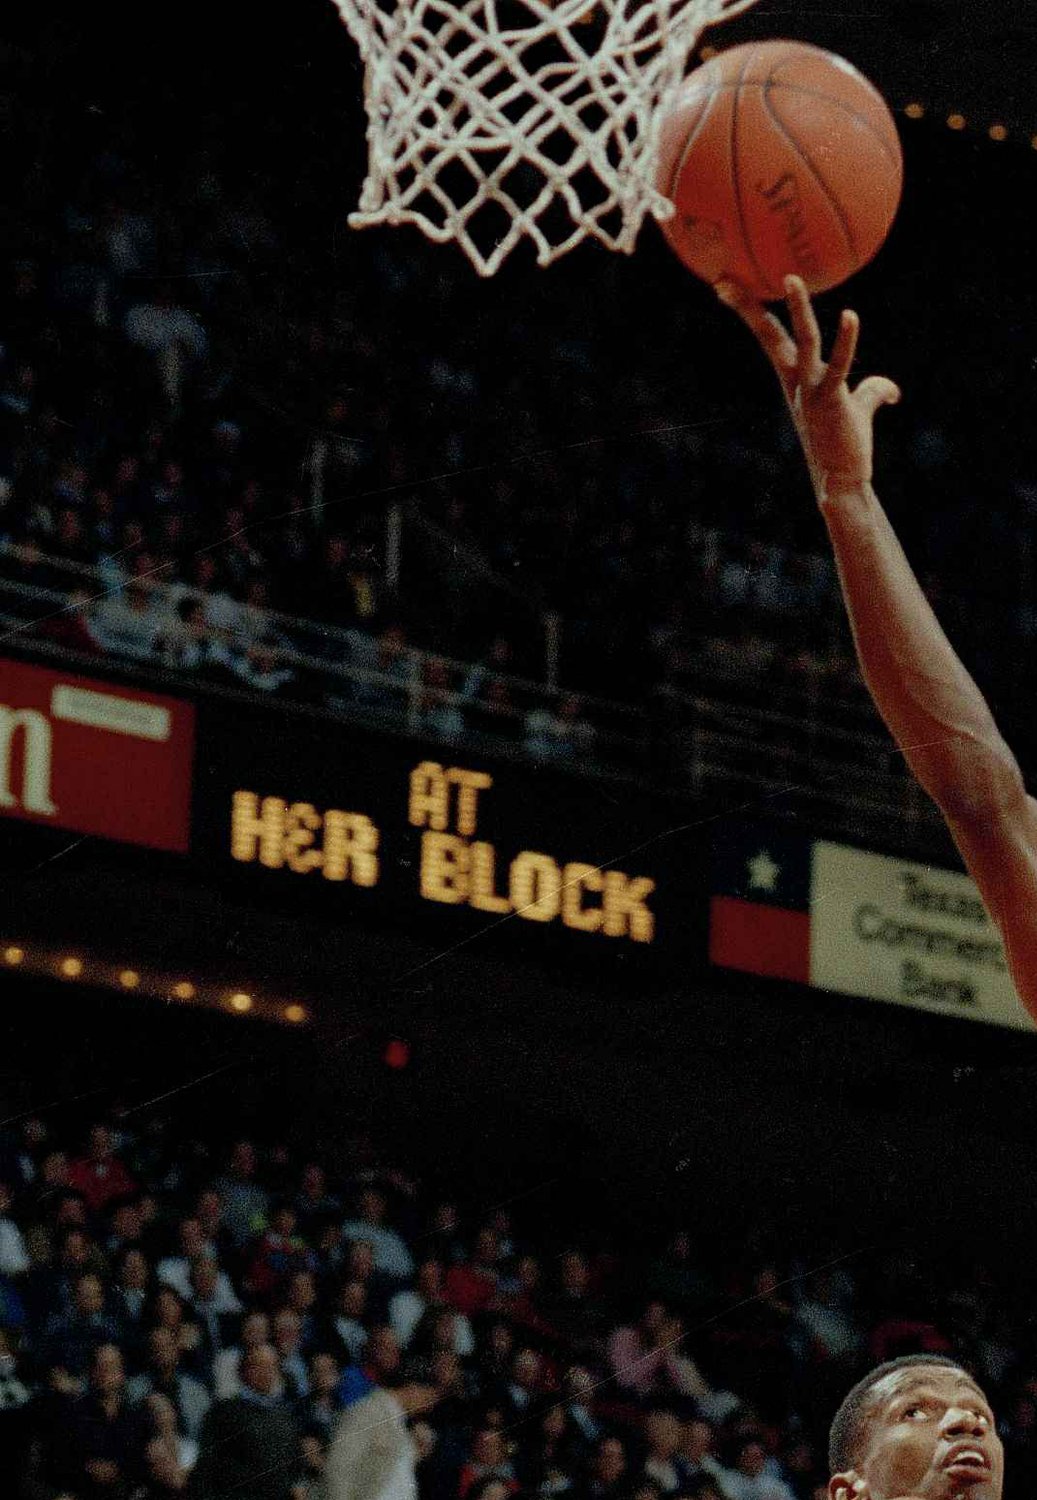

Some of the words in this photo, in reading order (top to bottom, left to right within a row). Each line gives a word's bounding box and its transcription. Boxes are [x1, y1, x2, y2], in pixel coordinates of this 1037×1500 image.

[408, 761, 491, 835] AT
[420, 831, 655, 943] BLOCK
[854, 901, 1006, 971] Commer
